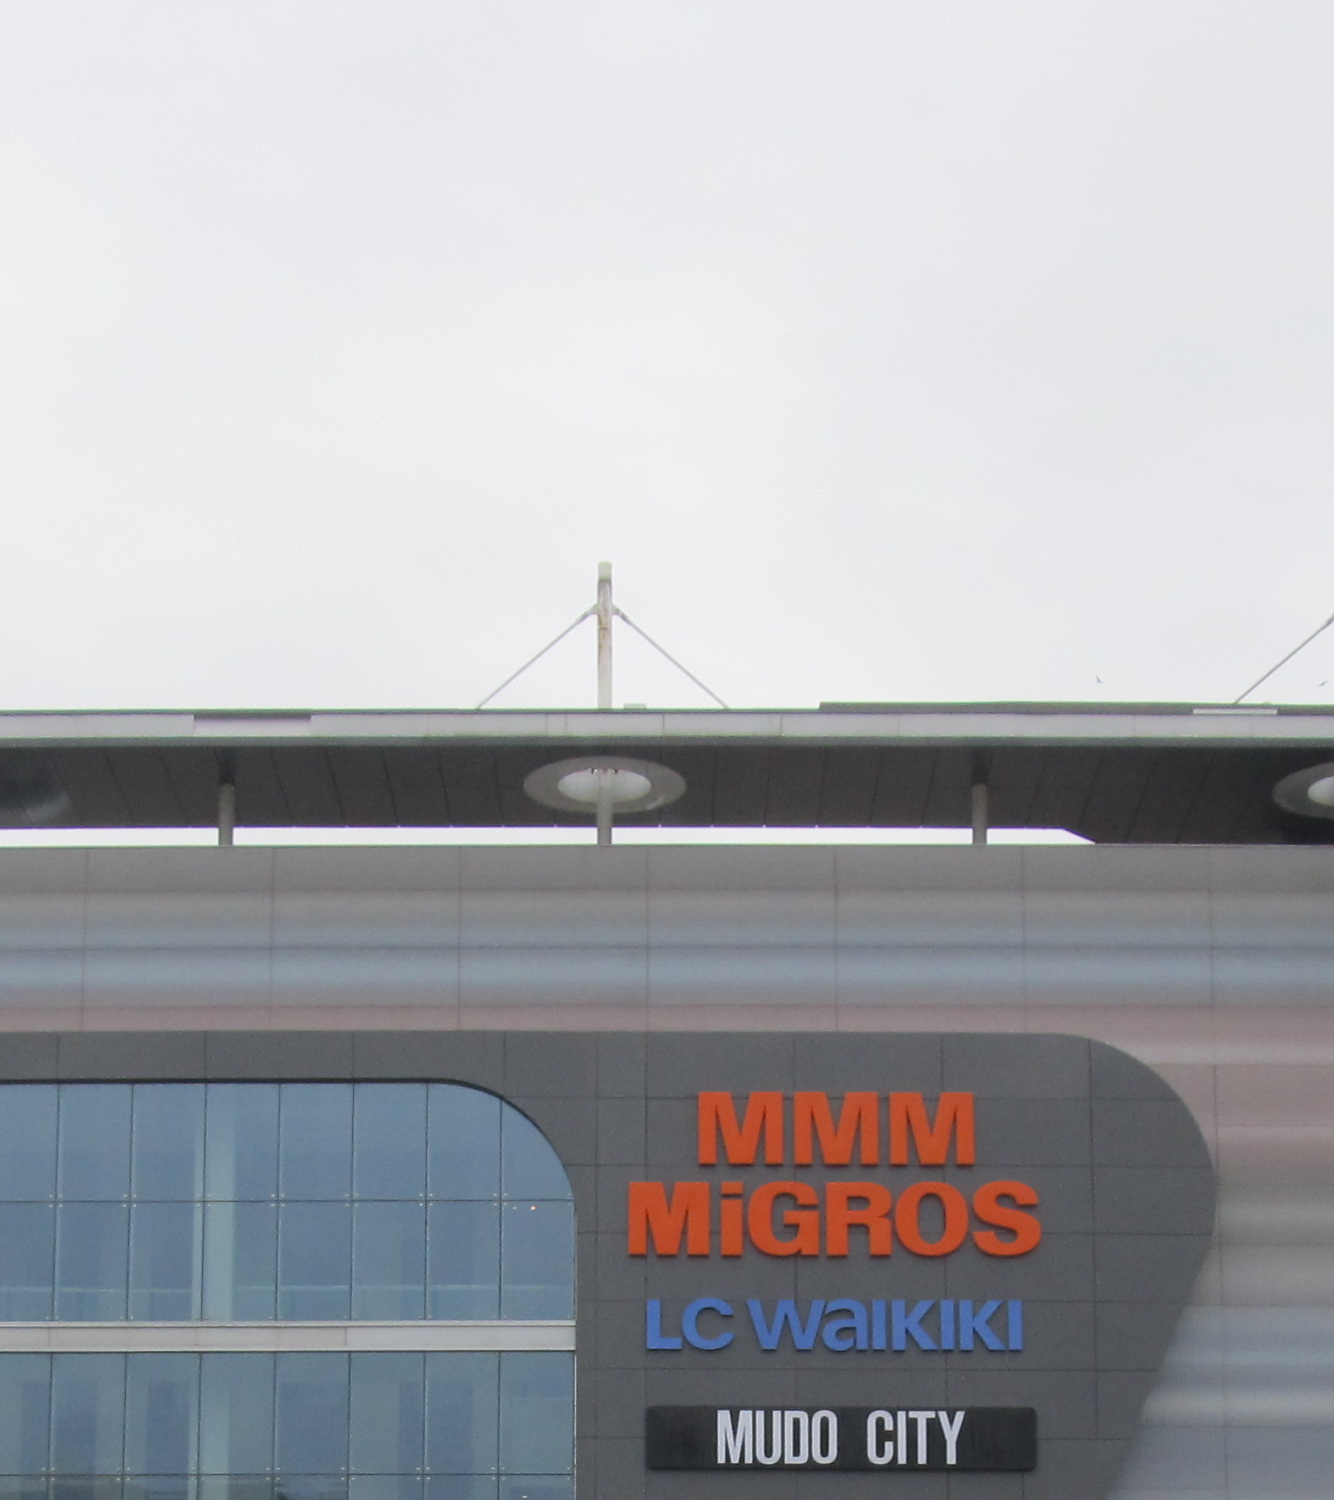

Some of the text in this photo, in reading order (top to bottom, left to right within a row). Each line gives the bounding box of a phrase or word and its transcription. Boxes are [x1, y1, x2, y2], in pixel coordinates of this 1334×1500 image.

[697, 1091, 975, 1167] MMM
[645, 1297, 735, 1351] LC
[716, 1409, 966, 1466] MUDO CITY
